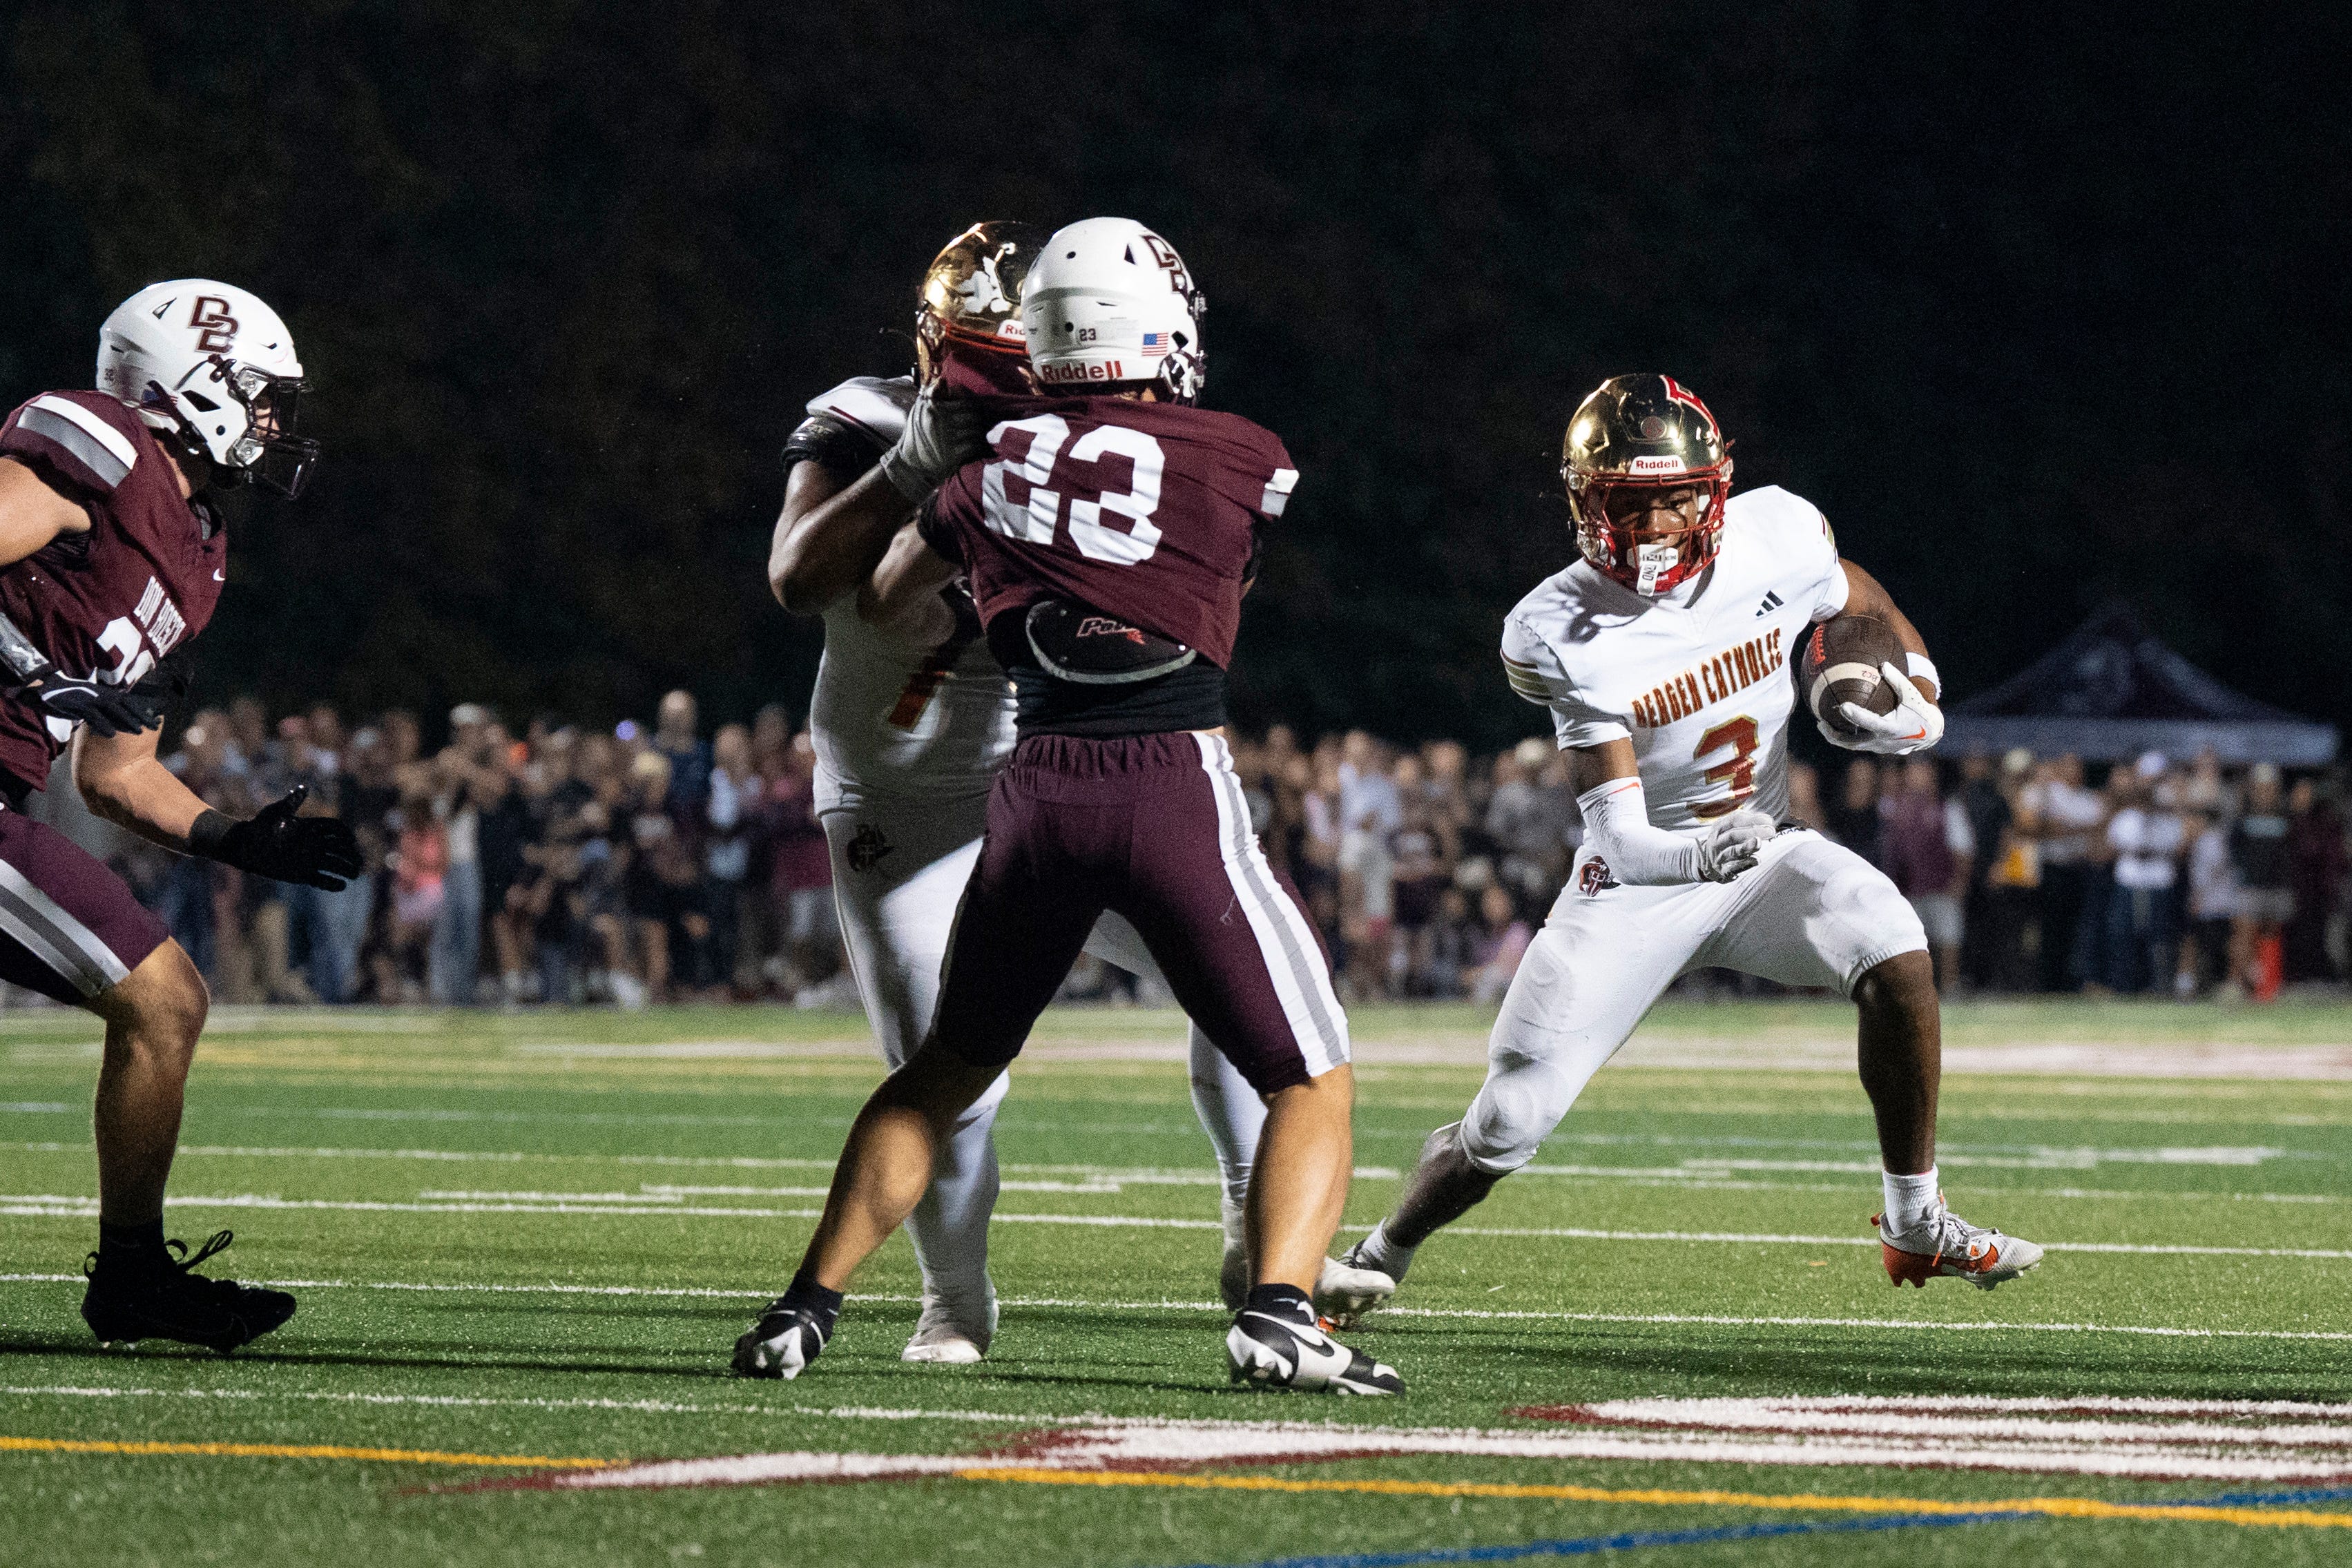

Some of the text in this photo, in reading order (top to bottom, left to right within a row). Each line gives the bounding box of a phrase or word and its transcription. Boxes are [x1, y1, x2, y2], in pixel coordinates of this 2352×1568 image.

[1079, 328, 1097, 341] 23
[1041, 360, 1123, 380] Riddell
[1635, 459, 1678, 469] Riddell
[982, 414, 1165, 565] 23
[1630, 626, 1783, 728] BERGEN CATHOLIC
[1862, 670, 1878, 682] BC2
[1686, 713, 1761, 824] 3
